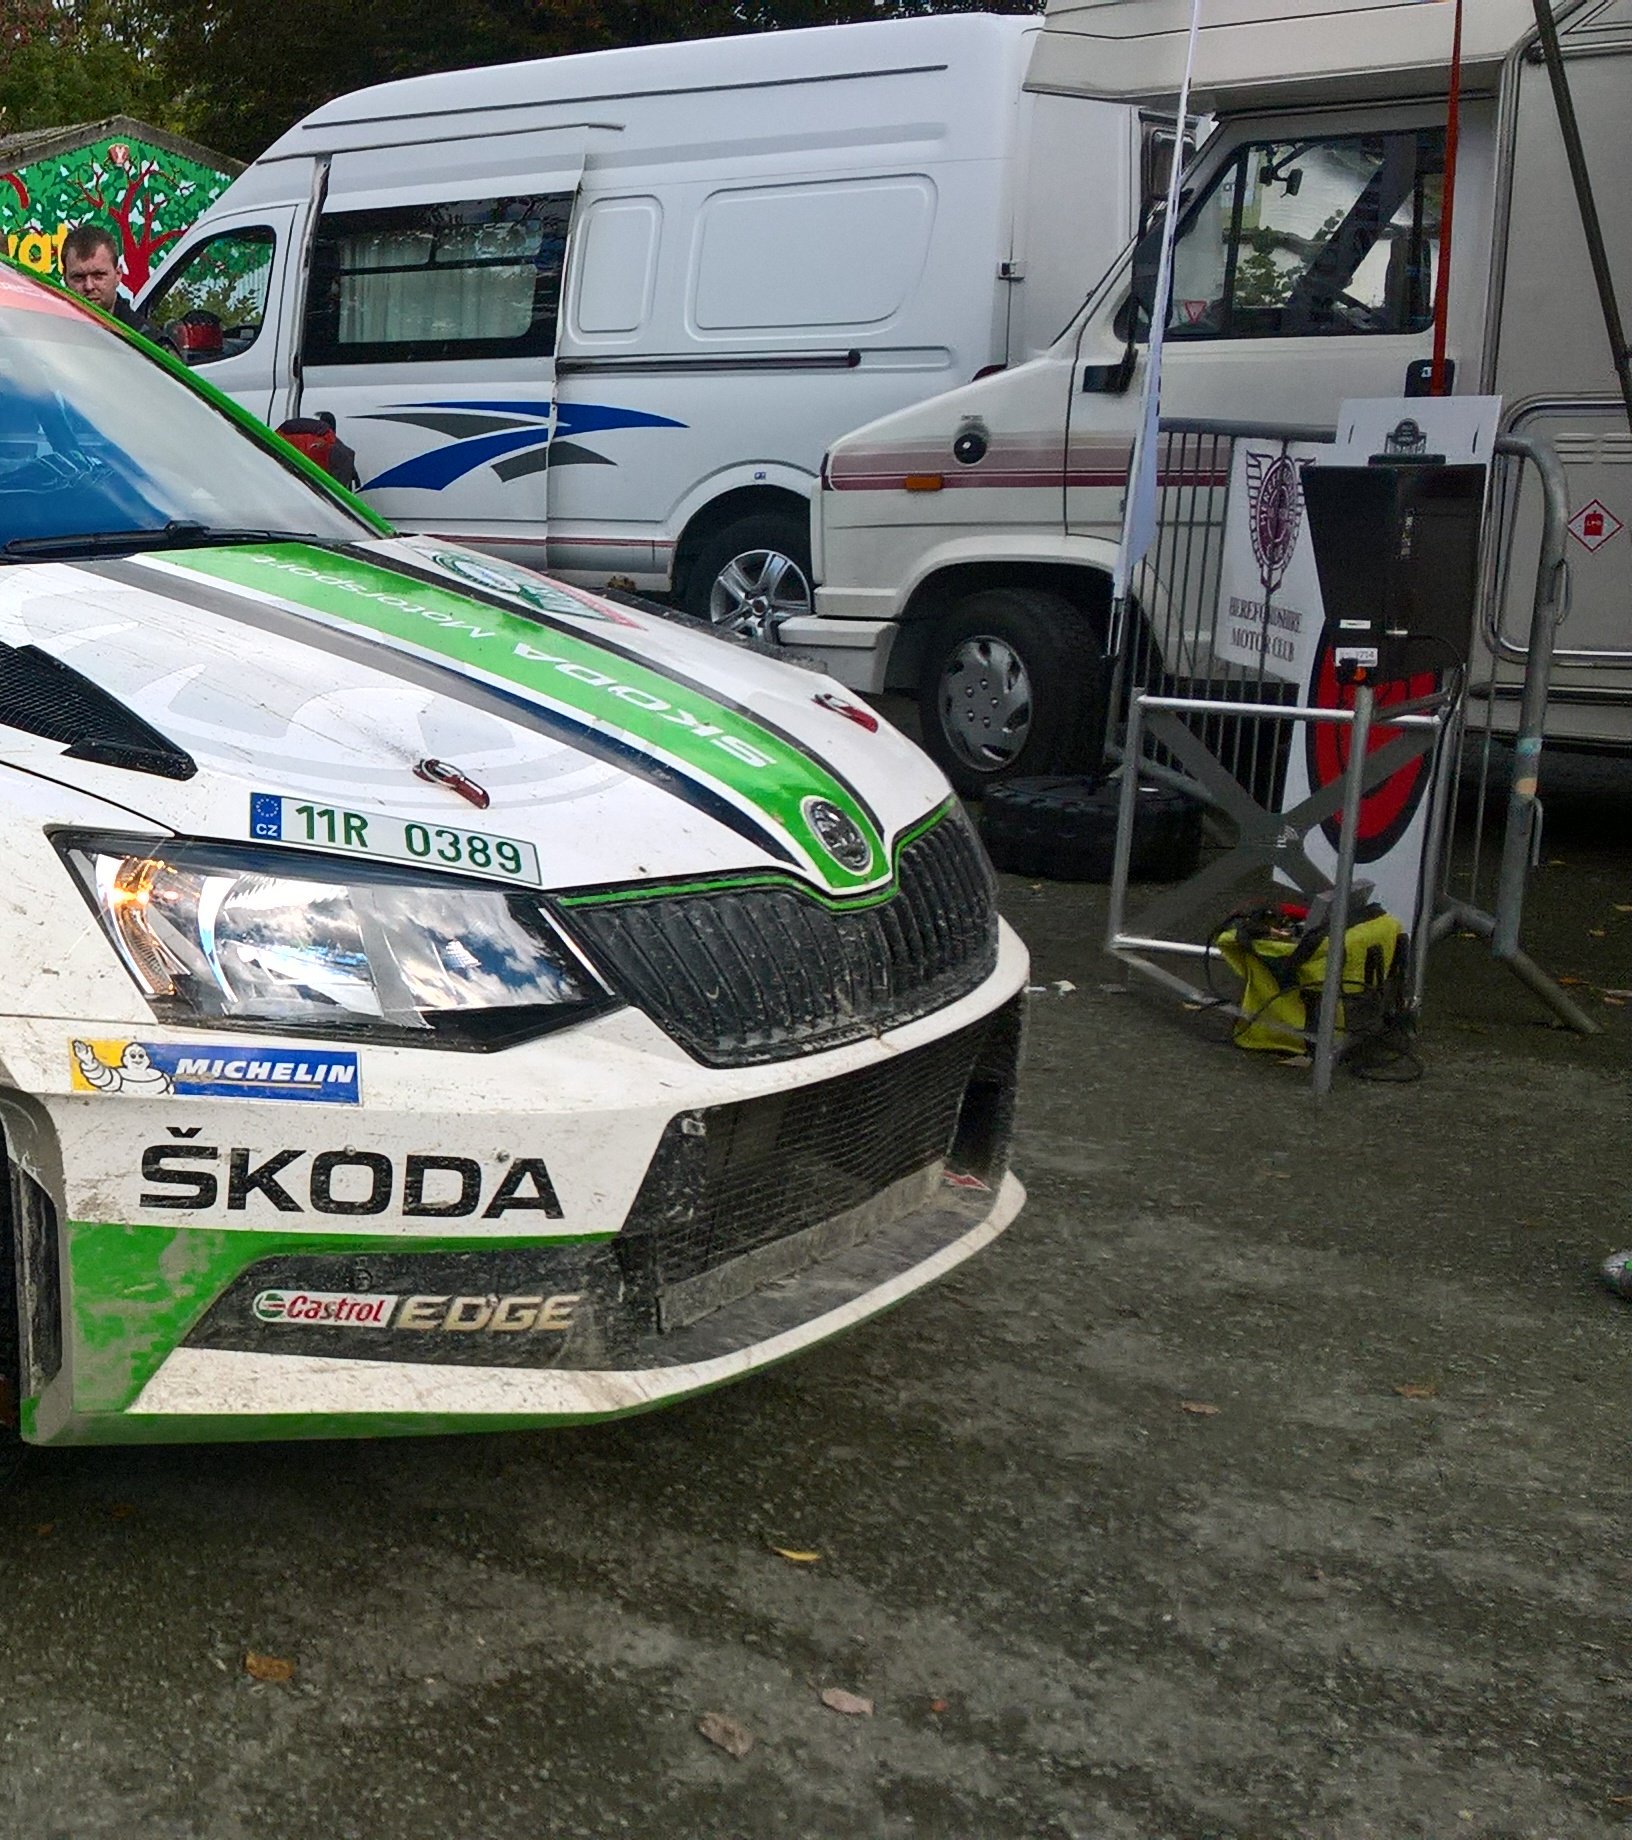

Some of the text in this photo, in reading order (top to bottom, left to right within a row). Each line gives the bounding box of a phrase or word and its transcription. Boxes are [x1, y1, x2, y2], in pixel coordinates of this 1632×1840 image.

[252, 555, 496, 639] Motorsport
[255, 805, 523, 875] CZ 11R 0389
[174, 1057, 356, 1085] MICHELIN
[138, 1126, 566, 1220] ŠKODA
[284, 1294, 583, 1333] Castrol EDGE
